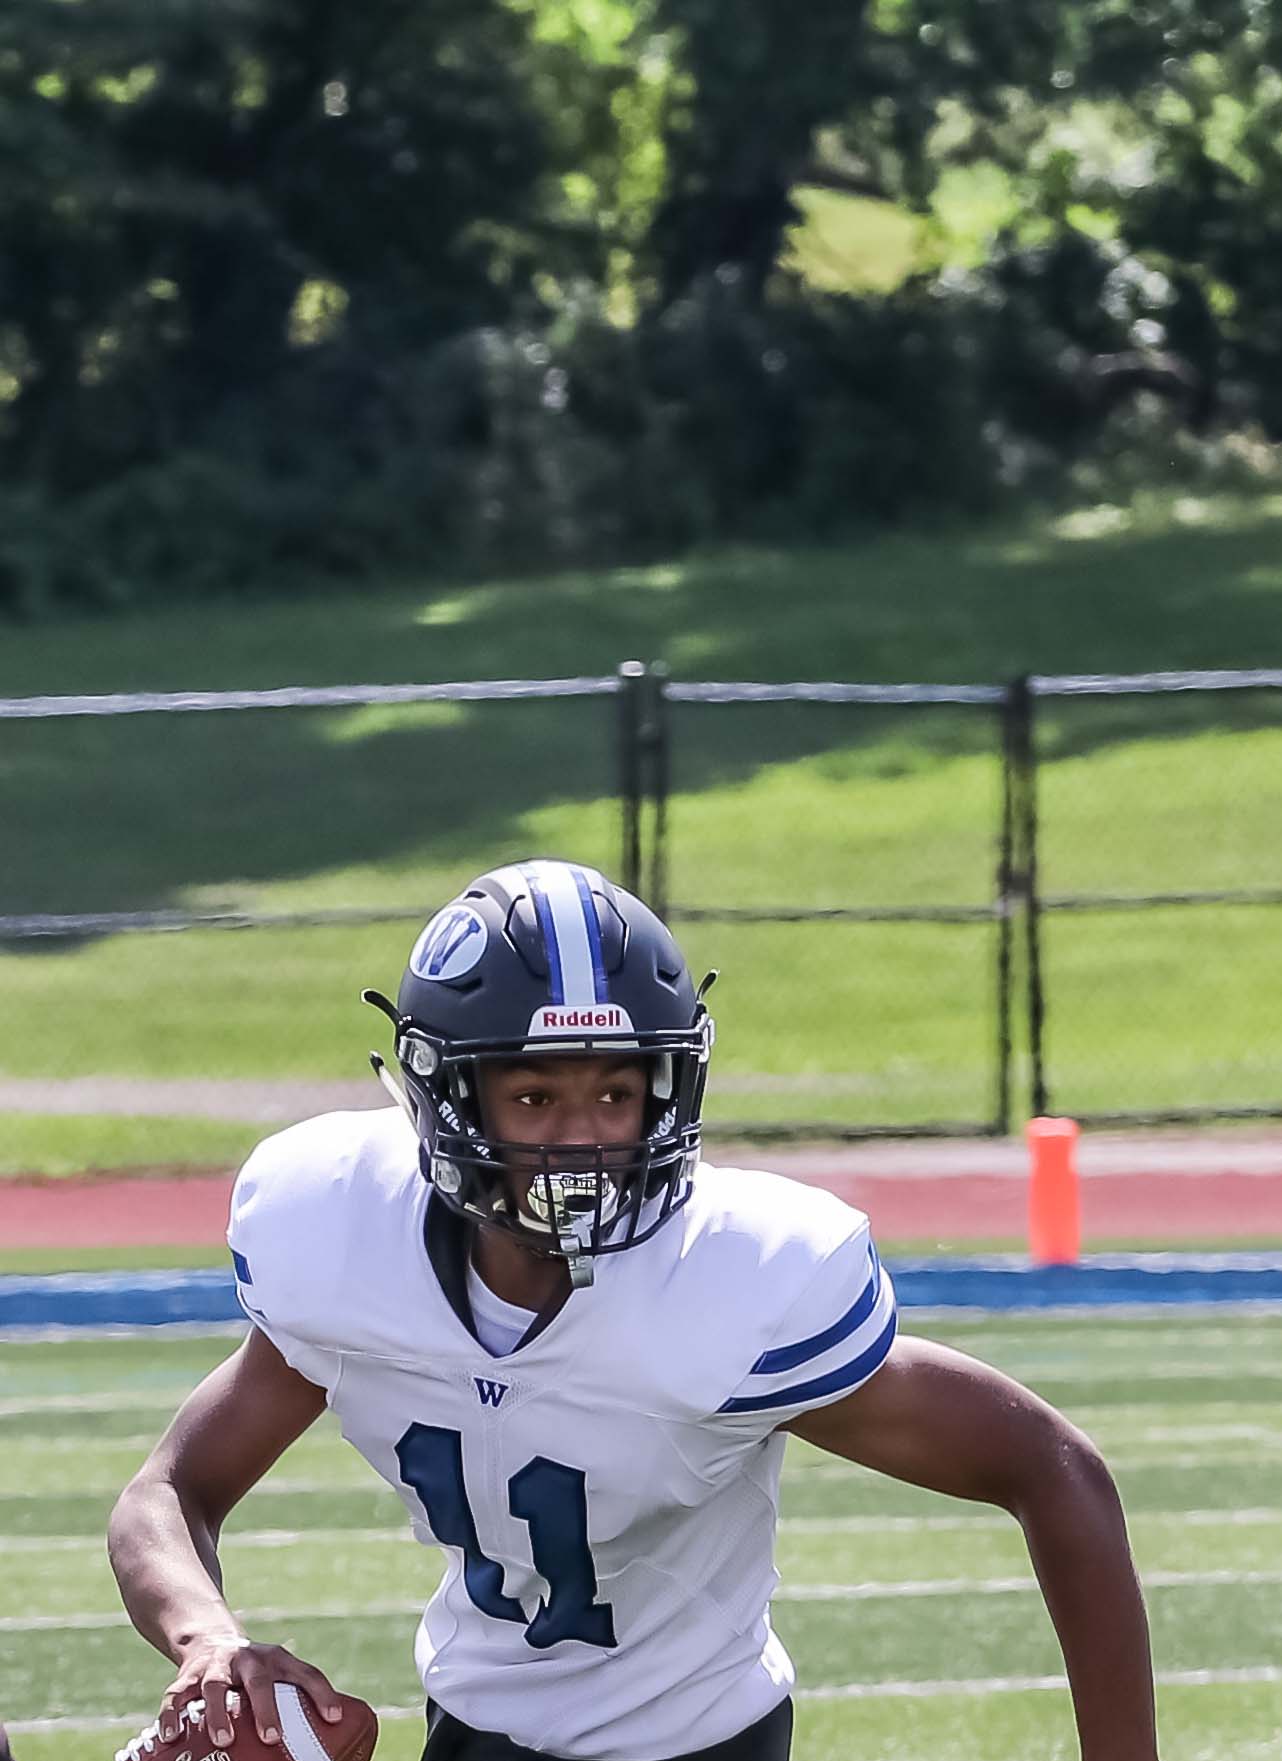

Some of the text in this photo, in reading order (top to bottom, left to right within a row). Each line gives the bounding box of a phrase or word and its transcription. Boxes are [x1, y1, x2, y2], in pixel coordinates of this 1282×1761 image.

[417, 909, 482, 976] W
[543, 1009, 622, 1028] Riddell
[473, 1376, 509, 1408] W
[394, 1421, 618, 1649] 11
